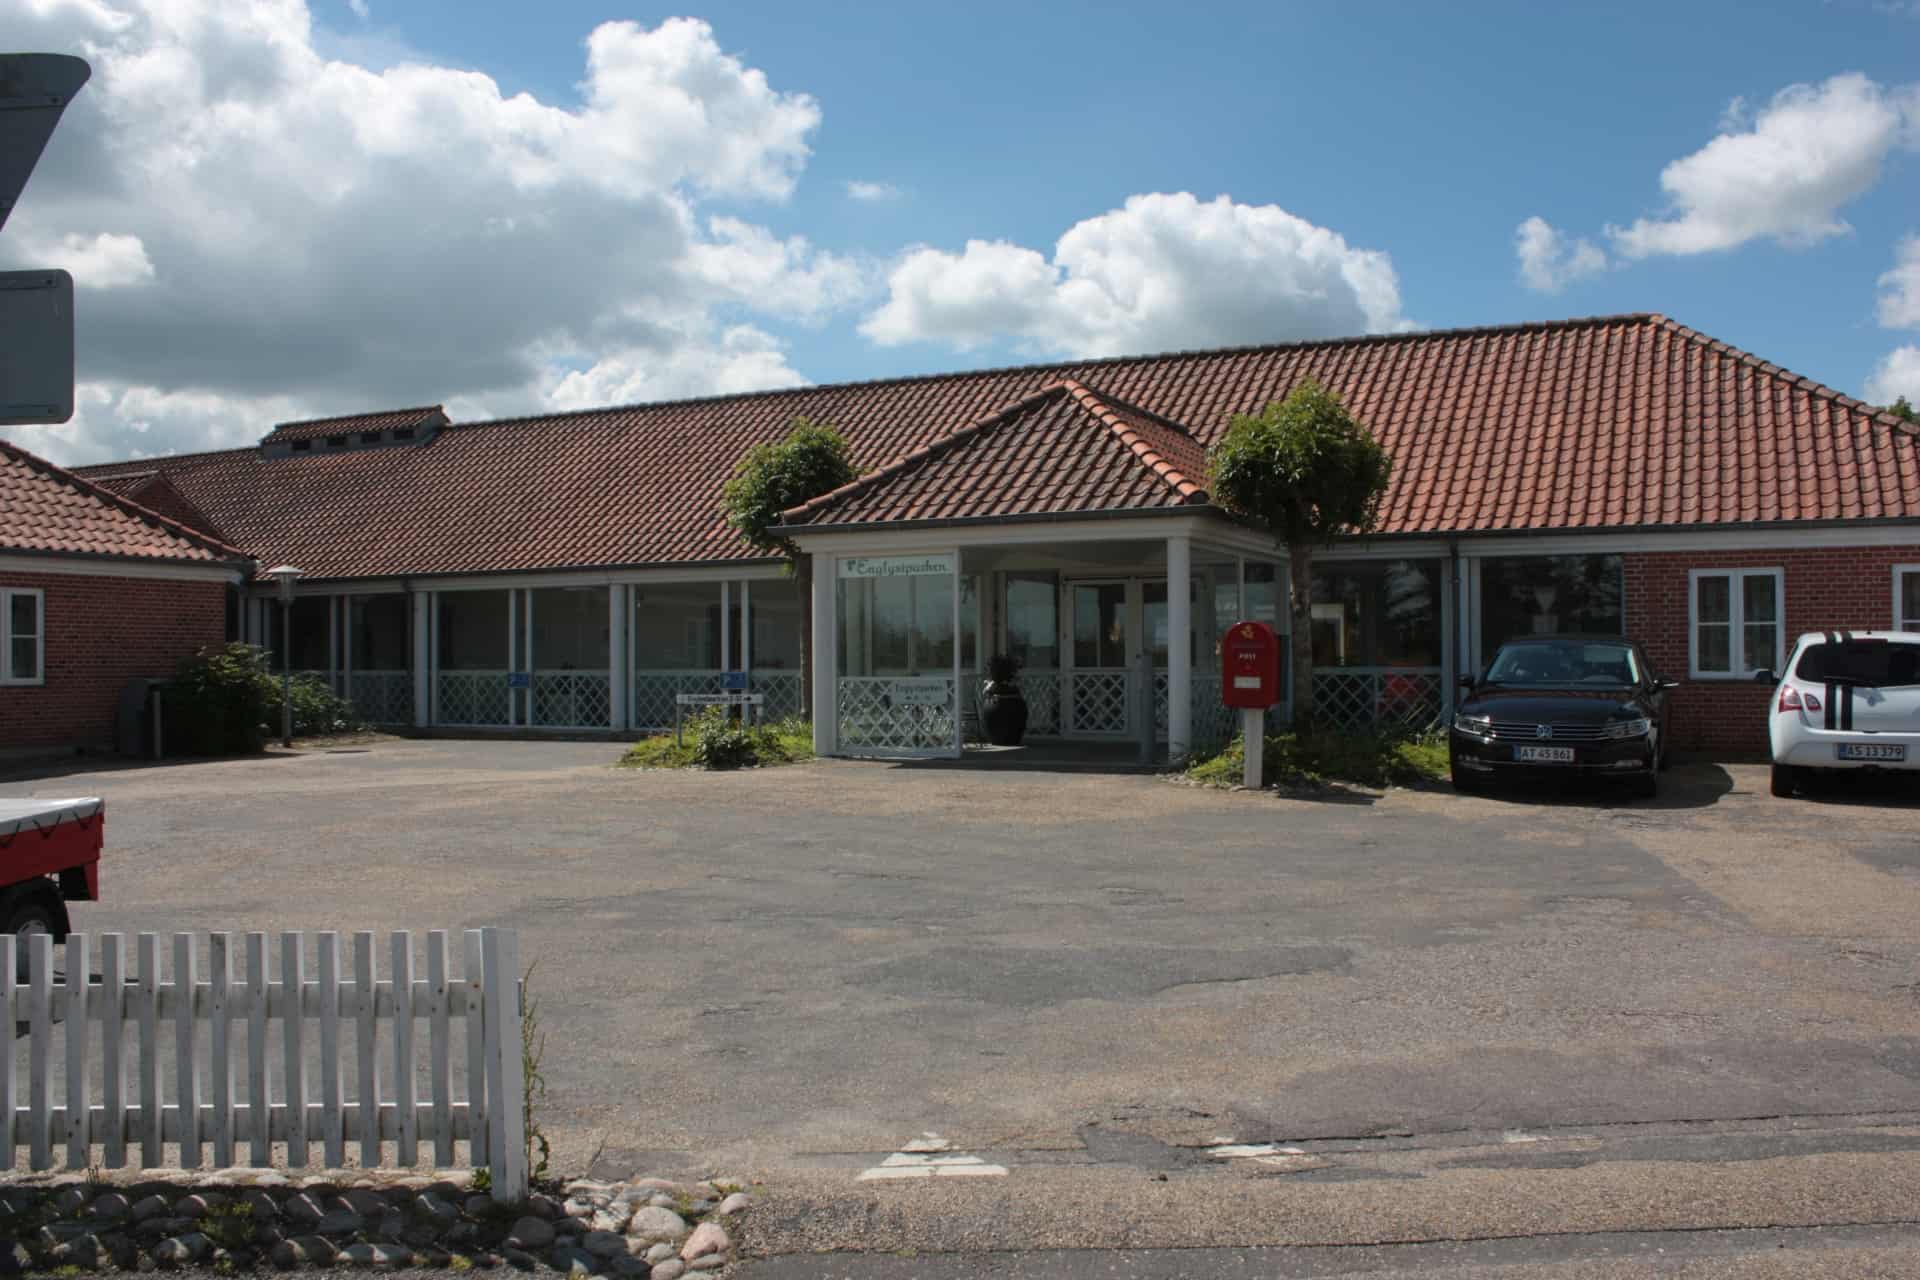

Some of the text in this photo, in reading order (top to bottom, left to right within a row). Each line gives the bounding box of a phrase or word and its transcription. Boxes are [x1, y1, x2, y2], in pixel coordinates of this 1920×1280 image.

[1239, 652, 1256, 661] POST
[1521, 748, 1536, 759] AT
[1847, 745, 1863, 756] AS
